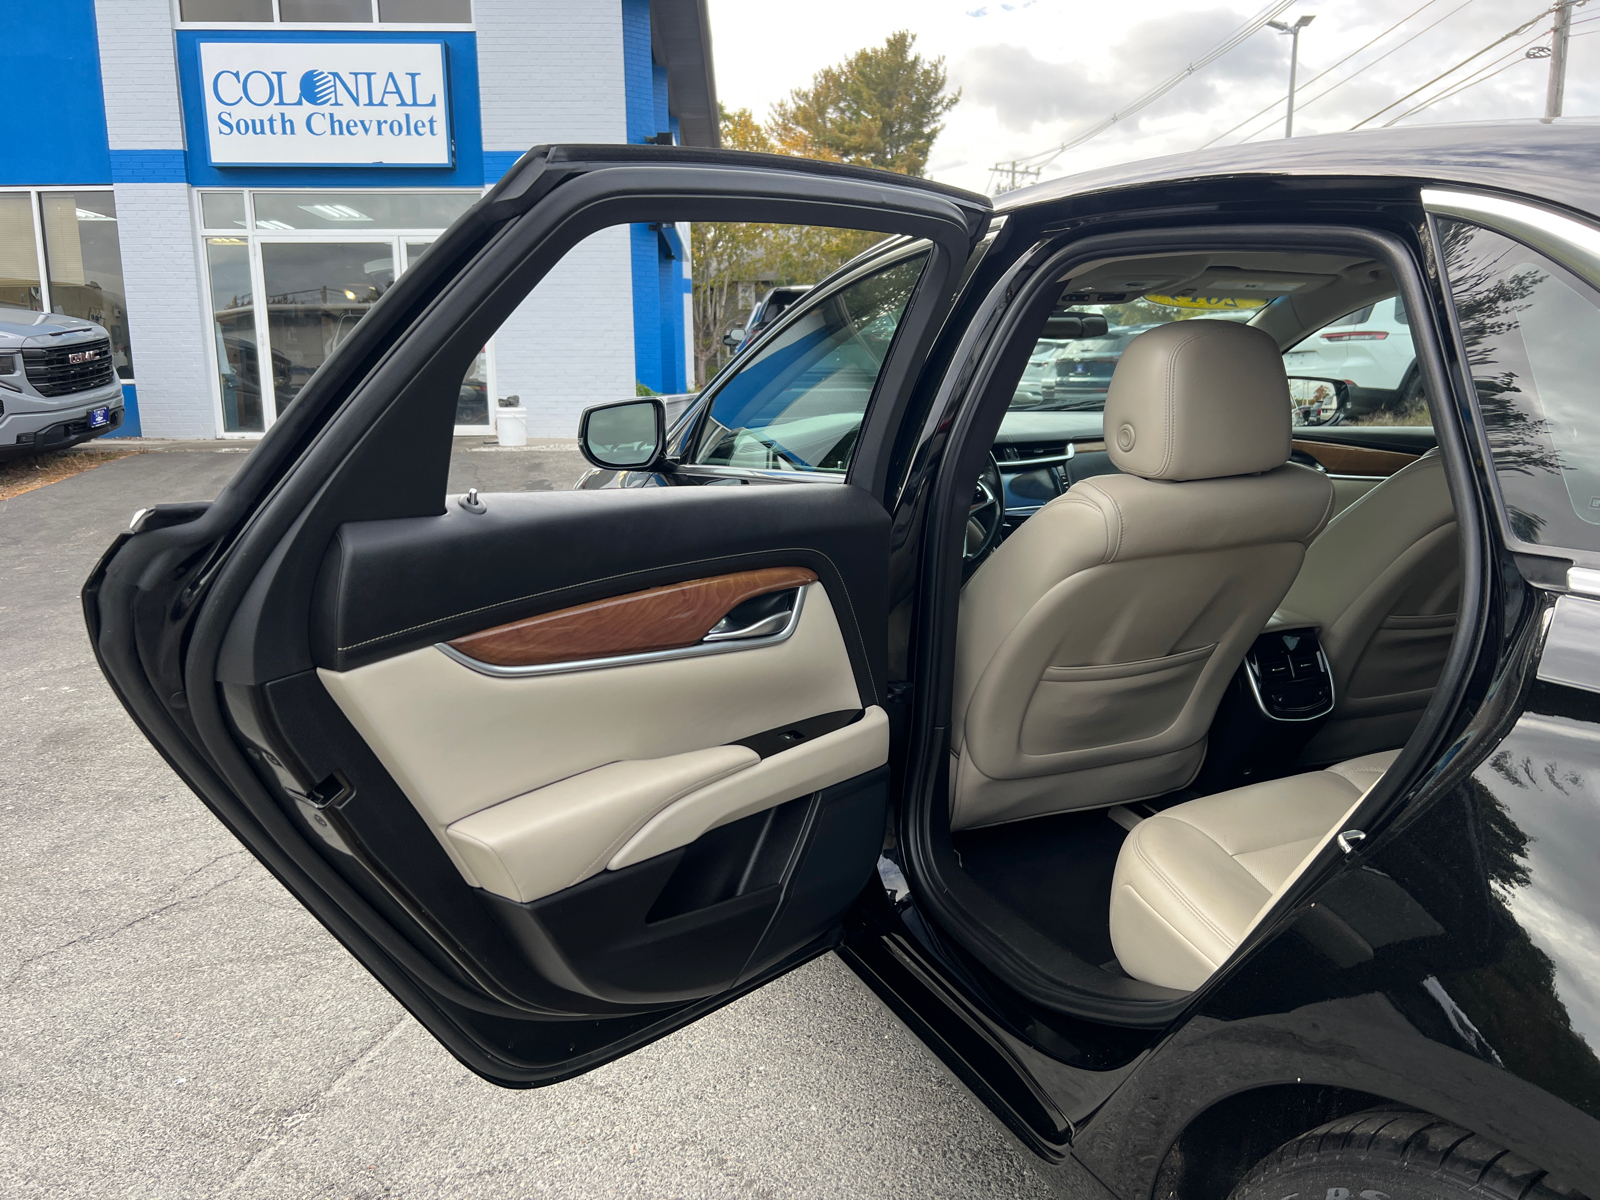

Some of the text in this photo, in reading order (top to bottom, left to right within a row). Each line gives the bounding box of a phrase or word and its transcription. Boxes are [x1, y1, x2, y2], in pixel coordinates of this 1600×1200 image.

[217, 111, 438, 137] South Chevrolet
[69, 350, 101, 364] GMC
